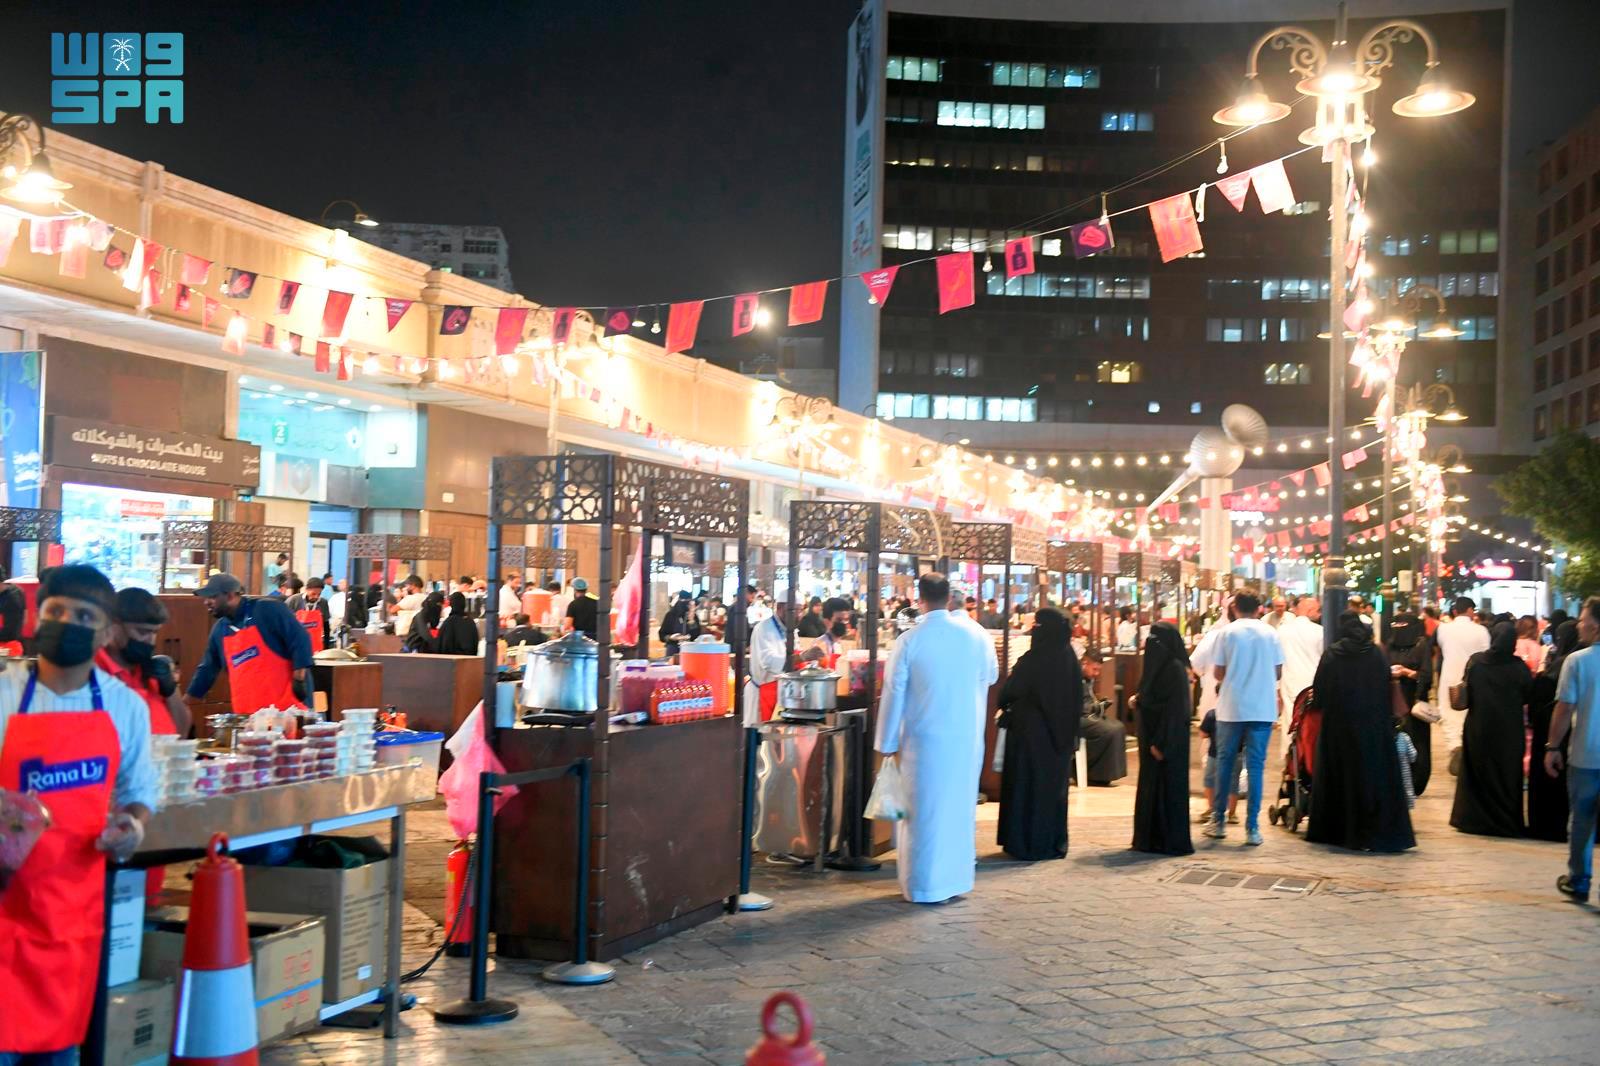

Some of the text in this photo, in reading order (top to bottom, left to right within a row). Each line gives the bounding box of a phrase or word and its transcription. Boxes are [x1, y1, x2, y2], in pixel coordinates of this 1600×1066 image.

[91, 453, 117, 466] NUTS
[127, 457, 178, 473] CHOCOLATE
[178, 463, 208, 477] HOUSE
[28, 768, 79, 791] Rana
